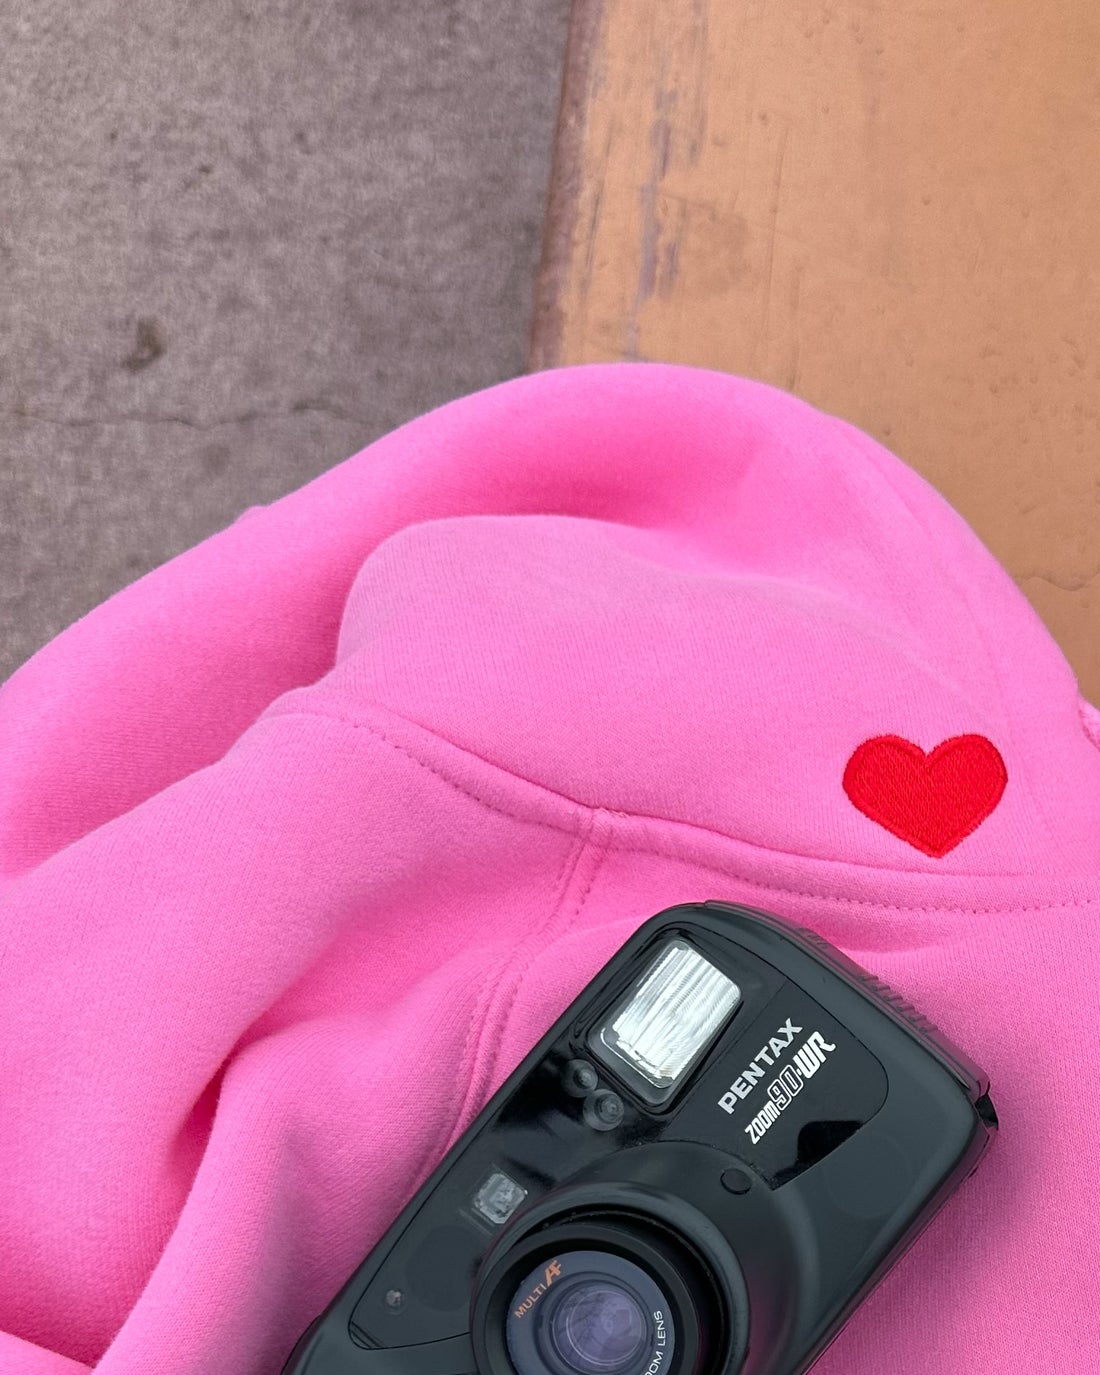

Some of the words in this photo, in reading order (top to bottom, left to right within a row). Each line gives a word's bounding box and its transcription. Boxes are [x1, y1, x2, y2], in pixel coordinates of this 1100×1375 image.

[718, 1017, 803, 1115] PENTAX
[514, 1283, 547, 1318] MULTI
[653, 1310, 666, 1347] LENS
